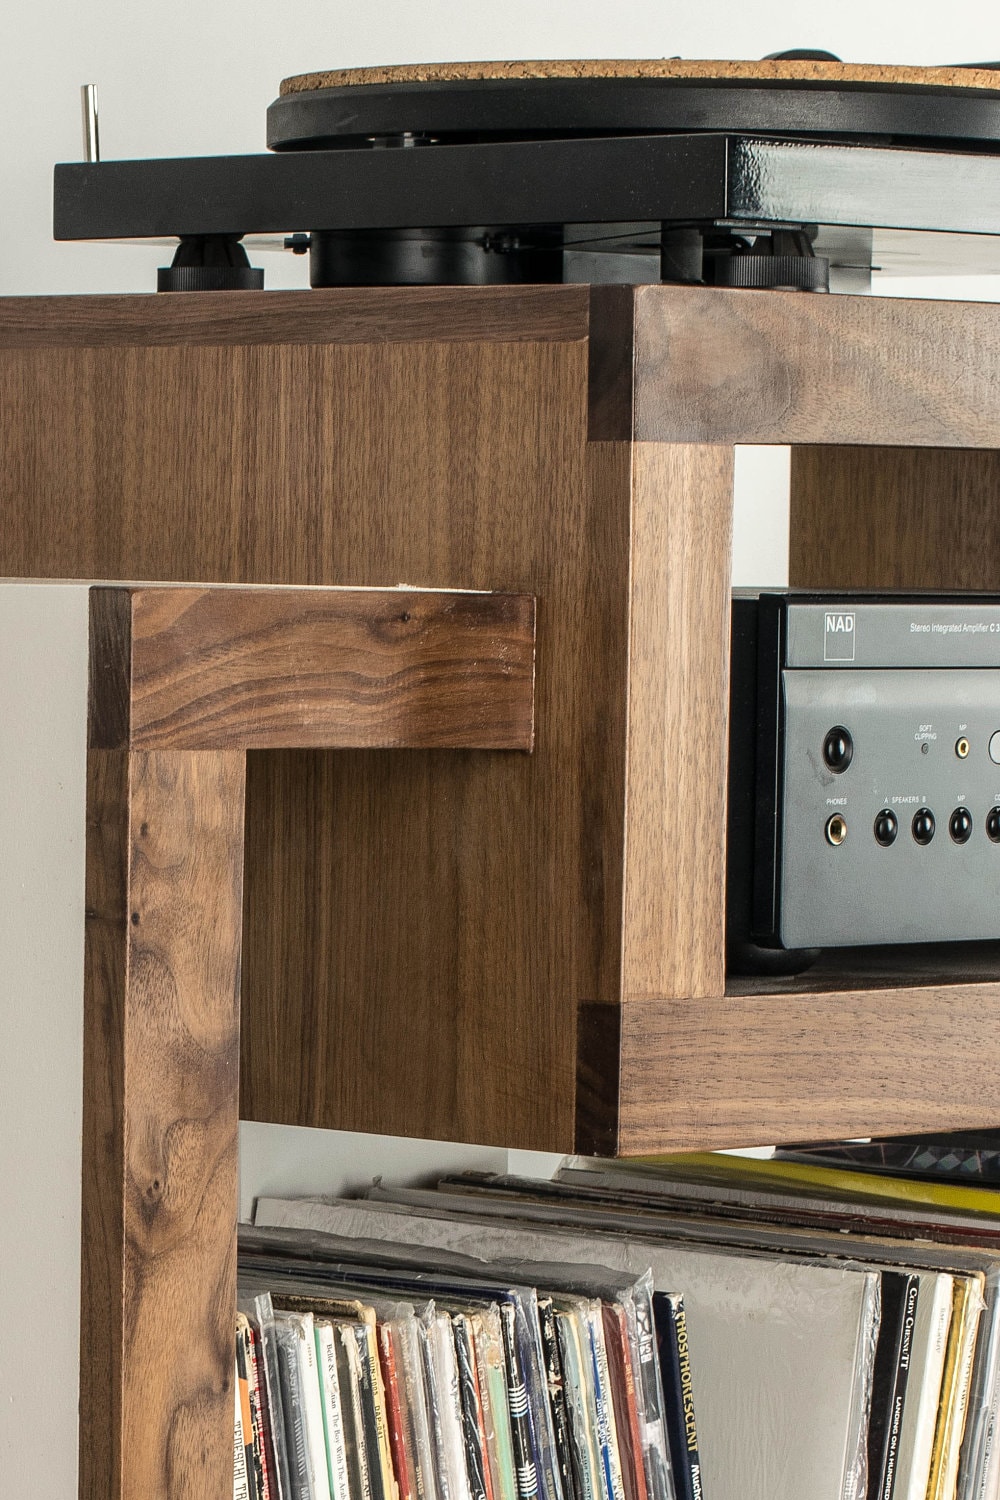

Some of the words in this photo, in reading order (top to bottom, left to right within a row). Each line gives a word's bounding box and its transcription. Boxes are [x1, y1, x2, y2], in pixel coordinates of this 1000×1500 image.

[826, 615, 854, 632] NAD
[910, 622, 931, 633] Stereo
[931, 623, 962, 635] Integrated
[962, 623, 989, 634] Amplifier
[989, 623, 995, 632] C
[826, 797, 848, 805] PHONES
[891, 796, 920, 804] SPEAKERS
[906, 1287, 918, 1316] CODY
[326, 1343, 335, 1363] Belle
[328, 1364, 336, 1372] &
[675, 1311, 698, 1452] PHOSPHORESCENT
[595, 1398, 604, 1418] JOHN
[891, 1396, 903, 1435] LANDING
[332, 1413, 341, 1428] The
[332, 1429, 342, 1443] Boy
[889, 1435, 898, 1449] ON
[983, 1436, 992, 1453] One
[334, 1445, 344, 1464] With
[889, 1449, 896, 1457] A
[336, 1465, 345, 1481] The
[980, 1455, 990, 1484] Nation
[415, 1465, 425, 1494] SINGS
[883, 1458, 896, 1500] HUNDRED
[338, 1482, 347, 1499] Arab
